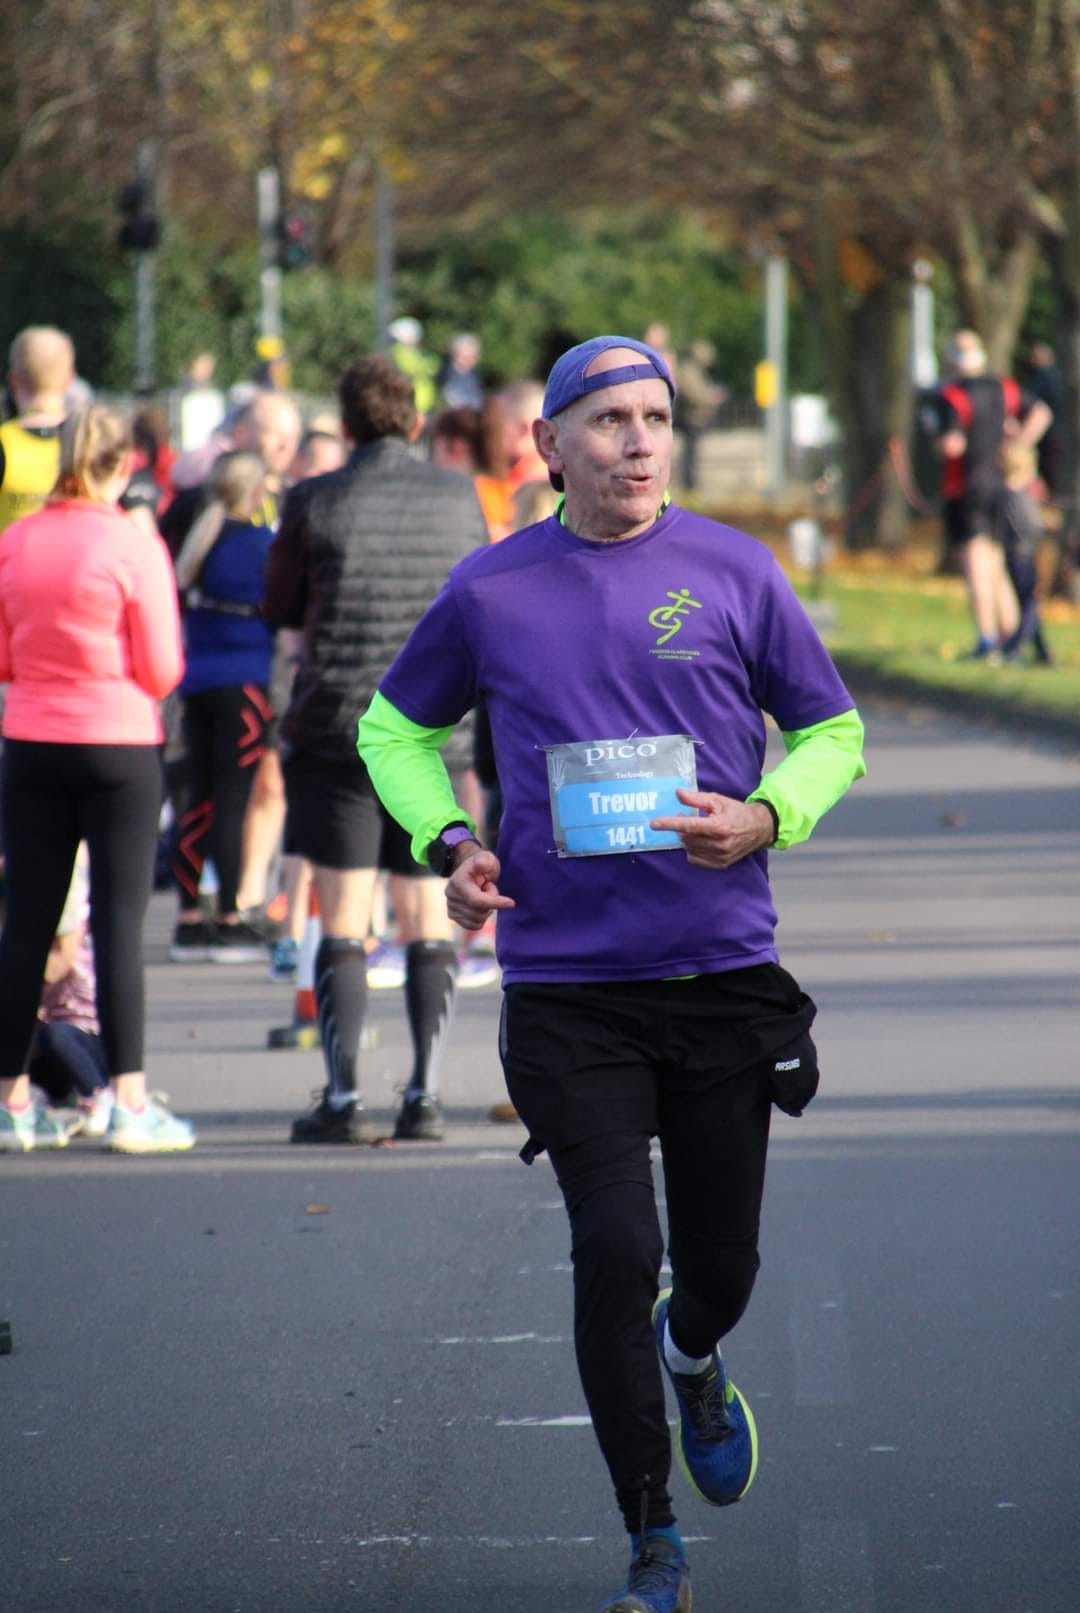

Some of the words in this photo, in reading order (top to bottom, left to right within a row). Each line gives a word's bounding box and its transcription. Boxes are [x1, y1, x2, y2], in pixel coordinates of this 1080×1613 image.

[585, 741, 657, 766] pico
[589, 791, 658, 815] Trevor
[606, 826, 646, 847] 1441
